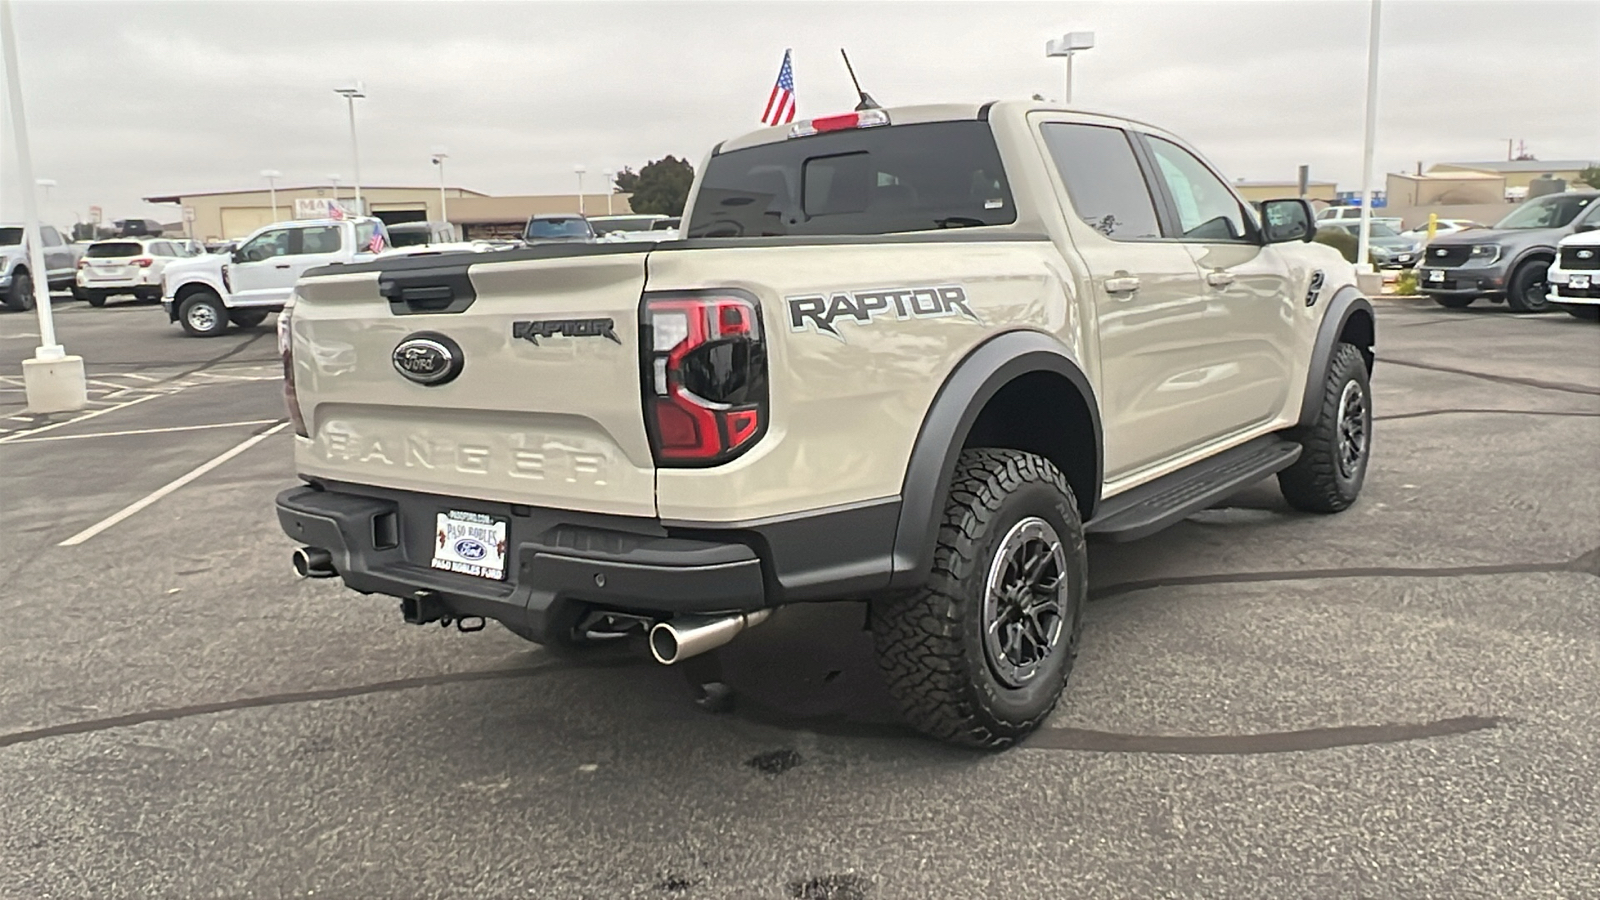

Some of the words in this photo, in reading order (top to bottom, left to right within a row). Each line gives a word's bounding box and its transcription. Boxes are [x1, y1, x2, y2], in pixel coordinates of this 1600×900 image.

[786, 286, 984, 343] RAPTOR
[513, 318, 622, 346] RAPTOR
[404, 348, 436, 370] Ford
[325, 431, 607, 486] RANGER
[447, 523, 467, 540] PASO
[468, 526, 498, 547] ROBLES
